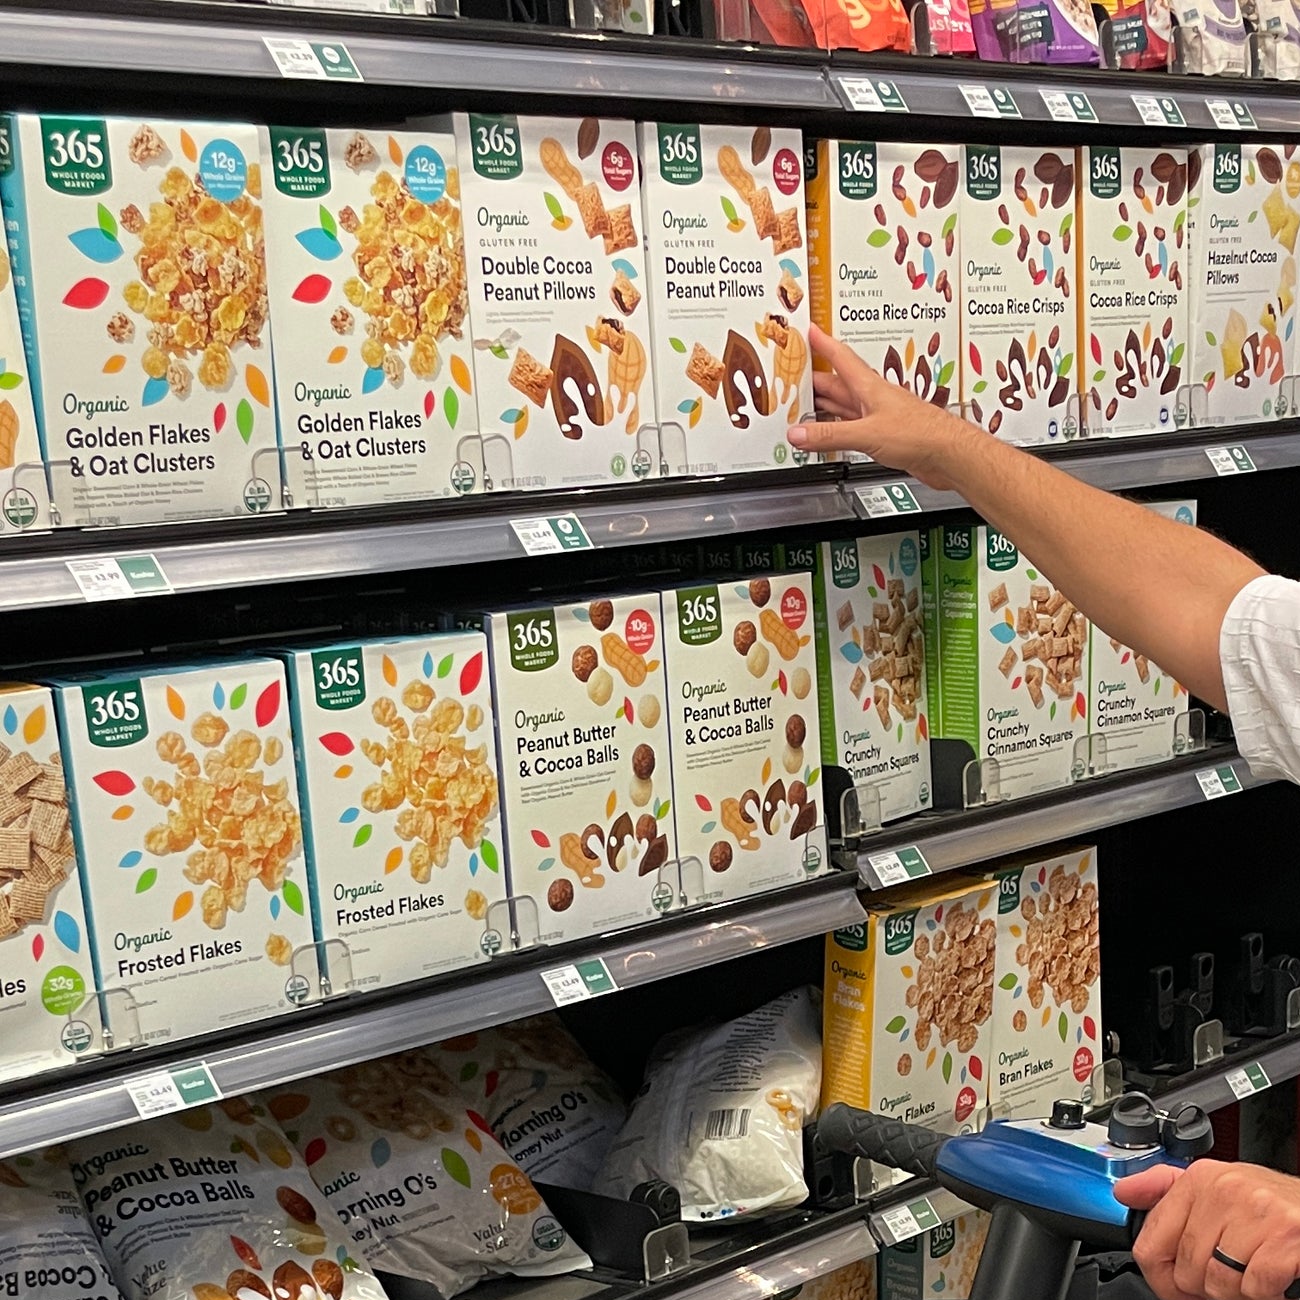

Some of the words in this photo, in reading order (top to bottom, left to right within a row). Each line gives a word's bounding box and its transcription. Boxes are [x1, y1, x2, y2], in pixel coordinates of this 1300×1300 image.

[931, 16, 972, 33] usters
[50, 130, 103, 168] 365
[476, 124, 516, 156] 365
[663, 132, 697, 163] 365
[211, 152, 235, 172] 12g
[278, 137, 323, 172] 365
[610, 152, 623, 167] 6g
[781, 158, 793, 172] 6g
[842, 150, 874, 179] 365
[1216, 152, 1238, 176] 365
[415, 157, 436, 176] 12g
[969, 154, 997, 180] 365
[1093, 154, 1118, 178] 365
[478, 207, 529, 232] Organic
[663, 210, 708, 234] Organic
[1210, 214, 1239, 233] Organic
[480, 239, 515, 247] GLUTEN
[519, 239, 537, 247] FREE
[664, 240, 695, 248] GLUTEN
[481, 256, 540, 275] Double
[544, 256, 592, 274] Cocoa
[666, 256, 716, 274] Double
[719, 256, 762, 273] Cocoa
[1090, 256, 1121, 275] Organic
[1208, 251, 1248, 265] Hazelnut
[1250, 250, 1277, 263] Cocoa
[839, 263, 878, 284] Organic
[968, 260, 1002, 280] Organic
[1206, 271, 1239, 285] Pillows
[484, 282, 540, 301] Peanut
[544, 282, 595, 300] Pillows
[667, 282, 715, 298] Peanut
[719, 280, 764, 297] Pillows
[1091, 294, 1122, 307] Cocoa
[1125, 292, 1145, 306] Rice
[1149, 290, 1177, 308] Crisps
[840, 305, 879, 321] Cocoa
[884, 304, 907, 320] Rice
[911, 303, 946, 322] Crisps
[968, 300, 1004, 315] Cocoa
[1007, 299, 1029, 313] Rice
[1033, 298, 1064, 315] Crisps
[294, 382, 352, 407] Organic
[63, 393, 129, 420] Organic
[297, 413, 364, 433] Golden
[370, 410, 421, 430] Flakes
[66, 425, 143, 448] Golden
[149, 424, 210, 445] Flakes
[302, 441, 314, 460] &
[318, 439, 351, 459] Oat
[356, 437, 426, 457] Clusters
[70, 457, 85, 477] &
[90, 457, 128, 476] Oat
[134, 453, 215, 473] Clusters
[946, 531, 968, 548] 365
[834, 548, 856, 571] 365
[682, 595, 716, 625] 365
[786, 597, 800, 609] 10g
[514, 619, 552, 650] 365
[631, 619, 647, 633] 10g
[319, 658, 359, 689] 365
[682, 679, 726, 702] Organic
[1098, 681, 1126, 698] Organic
[91, 691, 139, 725] 365
[684, 702, 730, 723] Peanut
[734, 696, 771, 714] Butter
[1098, 698, 1135, 712] Crunchy
[515, 708, 565, 731] Organic
[987, 708, 1018, 726] Organic
[1097, 712, 1141, 727] Cinnamon
[1144, 705, 1175, 722] Squares
[518, 731, 569, 754] Peanut
[574, 726, 616, 744] Butter
[686, 729, 695, 745] &
[700, 723, 741, 742] Cocoa
[746, 716, 774, 733] Balls
[843, 728, 871, 747] Organic
[987, 722, 1029, 740] Crunchy
[987, 738, 1037, 756] Cinnamon
[1039, 730, 1073, 747] Squares
[519, 761, 531, 777] &
[535, 754, 582, 774] Cocoa
[588, 746, 619, 765] Balls
[845, 746, 881, 764] Crunchy
[890, 750, 919, 768] Squares
[334, 880, 384, 902] Organic
[337, 900, 395, 926] Frosted
[400, 894, 444, 913] Flakes
[888, 917, 912, 938] 365
[114, 928, 173, 952] Organic
[118, 951, 184, 977] Frosted
[190, 940, 242, 962] Flakes
[832, 961, 866, 980] Organic
[49, 977, 74, 990] 32g
[837, 981, 861, 997] Bran
[833, 993, 865, 1011] Flakes
[999, 1048, 1029, 1065] Organic
[1000, 1067, 1022, 1085] Bran
[1025, 1058, 1053, 1077] Flakes
[561, 1091, 588, 1110] O's
[880, 1092, 912, 1112] Organic
[905, 1101, 935, 1121] Flakes
[542, 1128, 564, 1144] Nut
[72, 1144, 149, 1183] Organic
[84, 1163, 169, 1213] Peanut
[169, 1157, 238, 1177] Butter
[405, 1173, 437, 1195] O's
[97, 1215, 116, 1236] &
[117, 1189, 199, 1220] Cocoa
[201, 1180, 254, 1202] Balls
[373, 1213, 400, 1231] Nut
